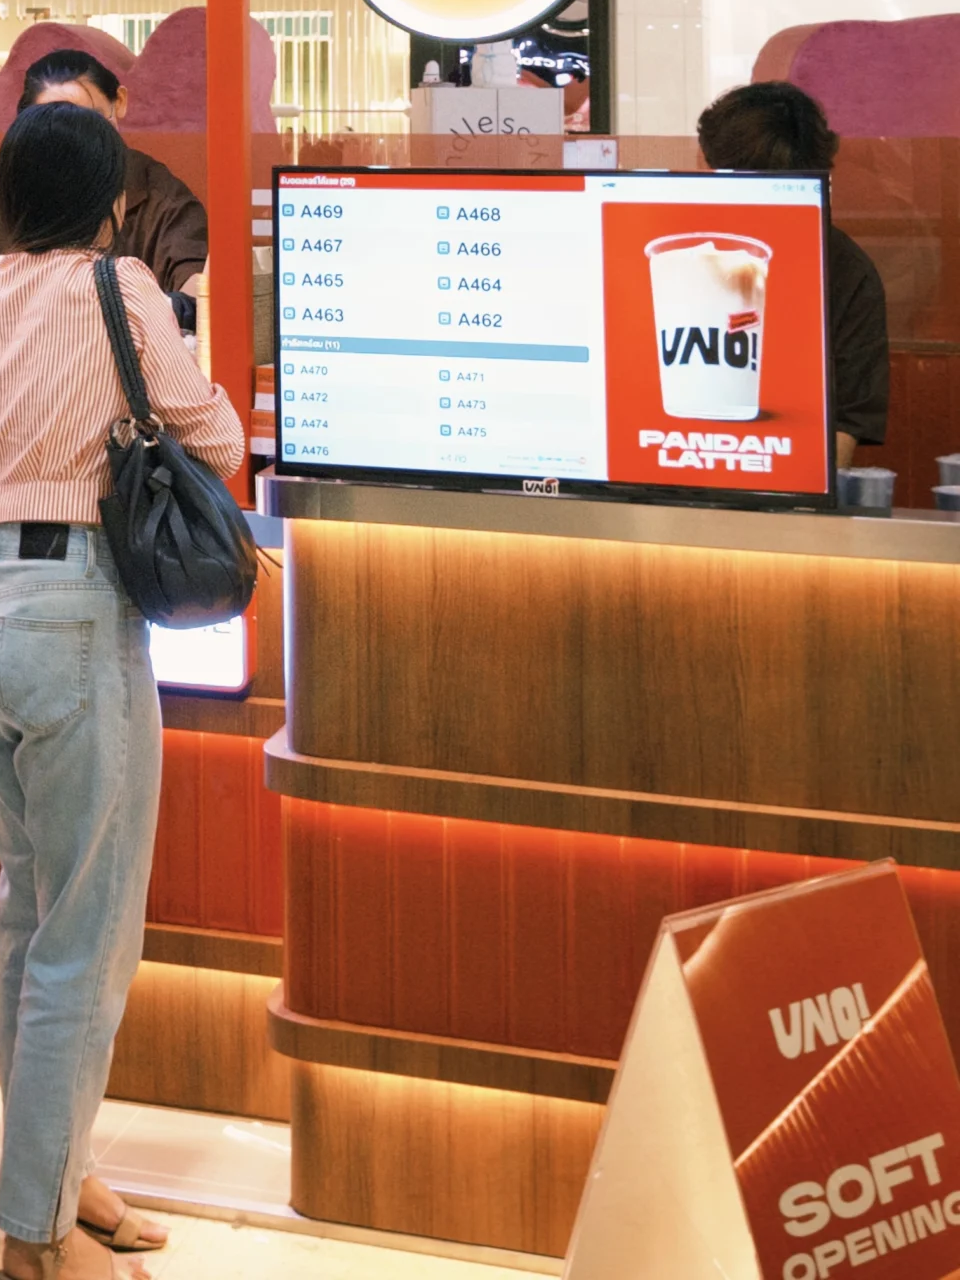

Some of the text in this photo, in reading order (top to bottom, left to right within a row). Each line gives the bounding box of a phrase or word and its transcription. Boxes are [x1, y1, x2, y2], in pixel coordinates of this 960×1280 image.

[300, 204, 343, 219] A469
[456, 207, 501, 221] A468
[301, 238, 343, 252] A467
[457, 242, 502, 256] A466
[301, 273, 344, 287] A465
[457, 277, 502, 291] A464
[302, 308, 344, 322] A463
[458, 313, 503, 328] A462
[661, 326, 758, 372] UNO!
[300, 366, 328, 375] A470
[456, 372, 485, 382] A471
[301, 392, 328, 402] A472
[457, 399, 486, 410] A473
[301, 419, 328, 429] A474
[457, 427, 487, 437] A475
[639, 429, 791, 455] PANDAN
[301, 446, 329, 456] A476
[658, 449, 772, 472] LATTE!
[524, 481, 559, 496] UNO!
[768, 982, 875, 1060] UNO!
[779, 1132, 945, 1238] SOFT
[782, 1190, 960, 1280] OPENING
